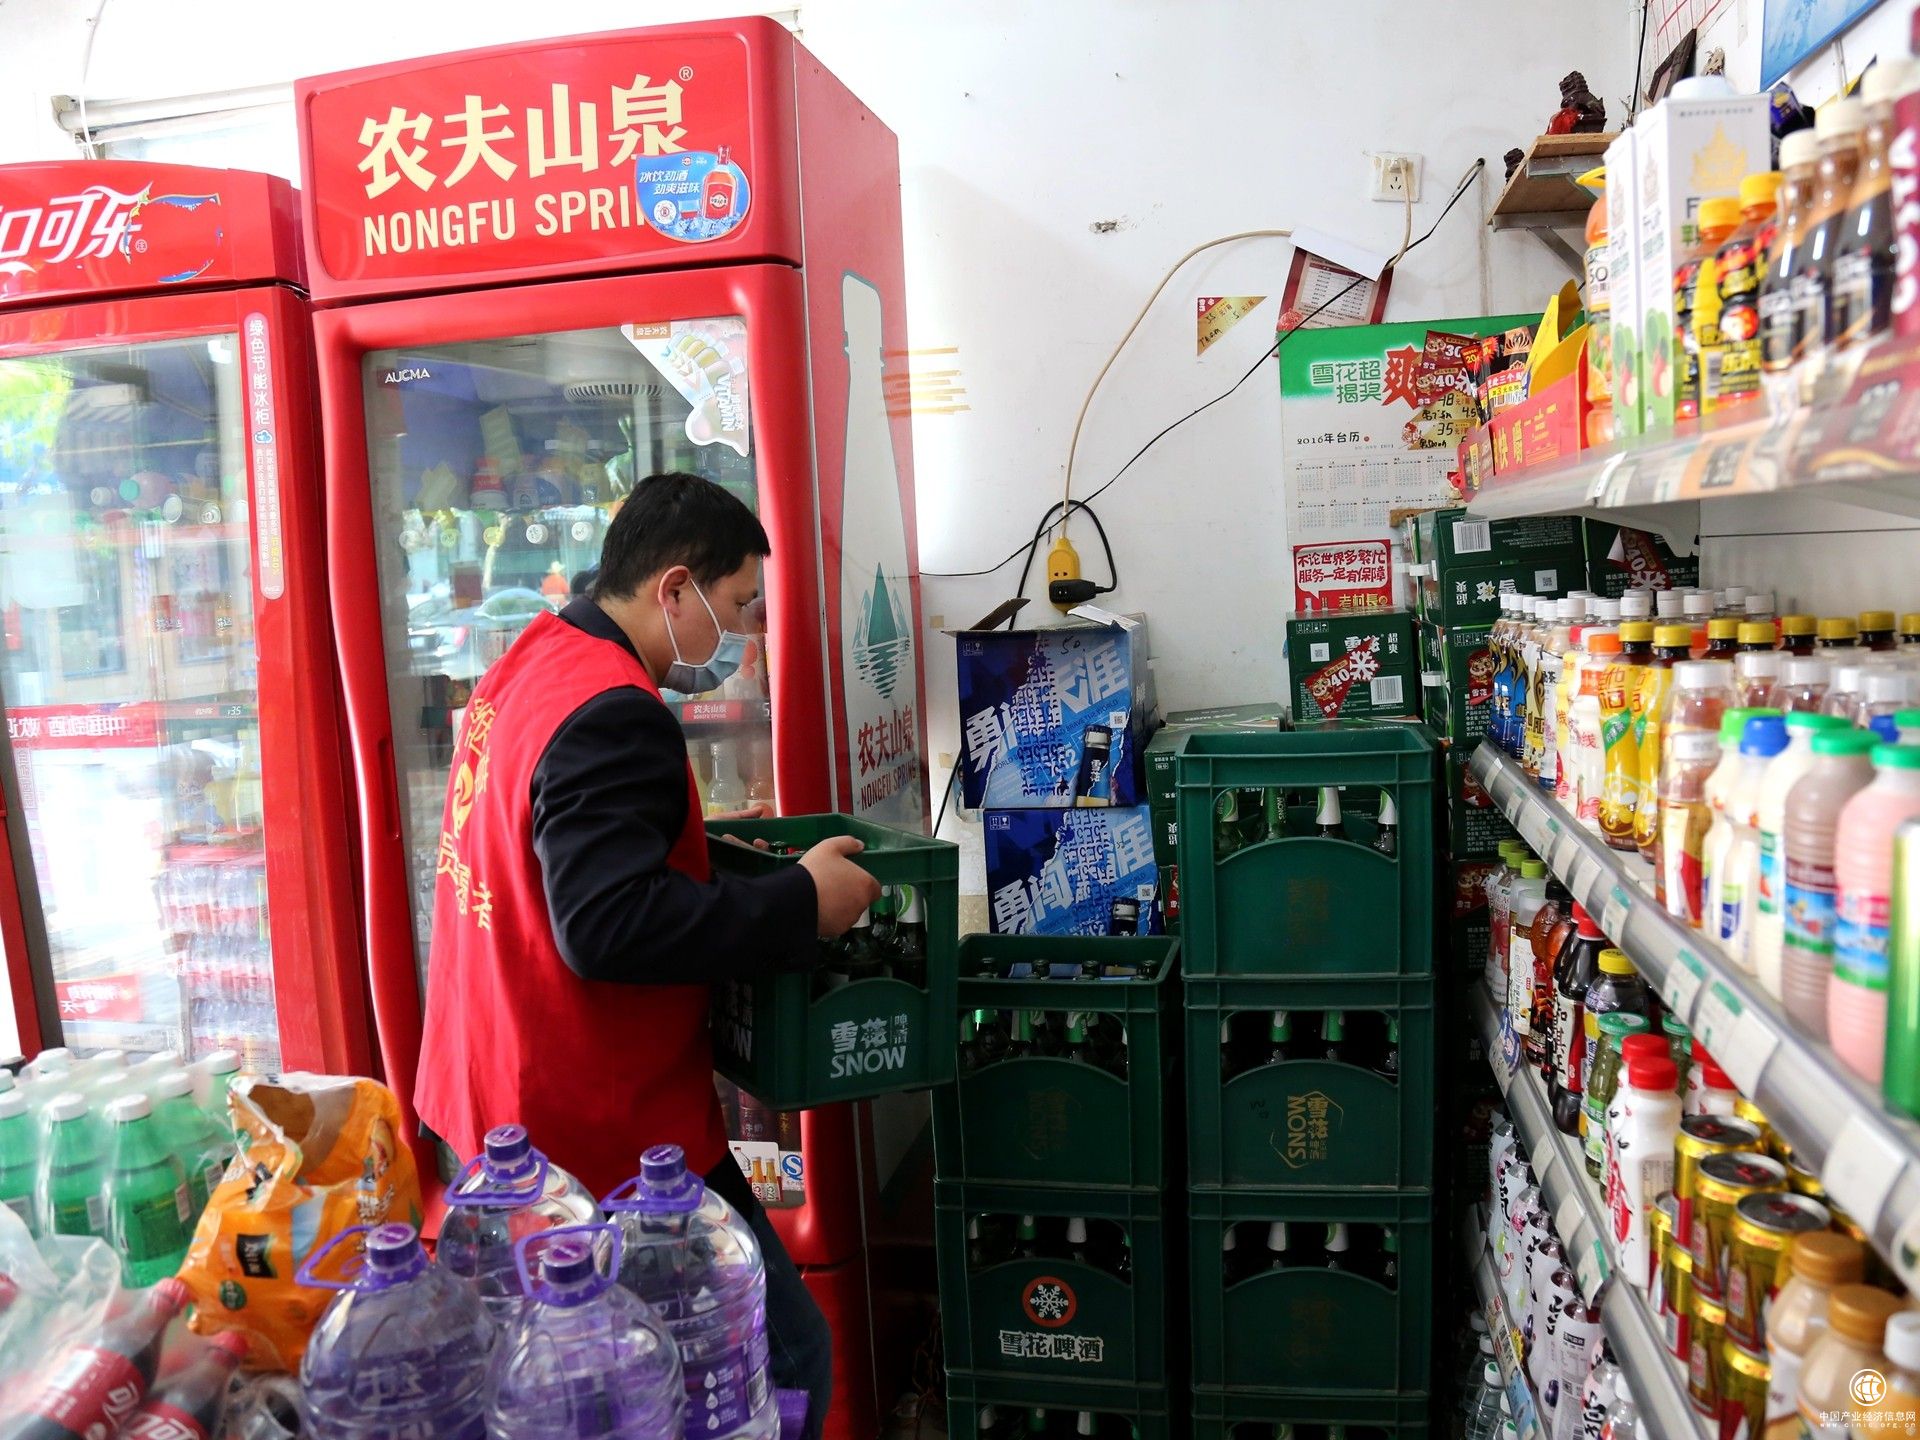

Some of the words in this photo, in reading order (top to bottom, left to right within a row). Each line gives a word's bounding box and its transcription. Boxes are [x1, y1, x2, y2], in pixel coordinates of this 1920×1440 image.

[357, 74, 689, 199] 农夫山泉
[363, 198, 516, 257] NONGFU
[535, 186, 645, 237] SPRI
[250, 319, 270, 426] 绿色节能冰柜
[384, 367, 430, 384] AUCMA
[1311, 361, 1381, 384] 雪花超
[1435, 374, 1455, 388] 40
[1336, 382, 1382, 404] 揭奖
[1297, 432, 1360, 445] 2016年台历
[1298, 549, 1386, 567] 不论世界多繁忙
[1299, 566, 1386, 583] 服务一定有保障
[1455, 580, 1468, 606] 超爽
[1387, 632, 1399, 654] 超爽
[1331, 668, 1351, 687] 40
[857, 704, 914, 778] 农夫山泉
[860, 772, 892, 811] NONGFU
[893, 758, 917, 791] SPRING
[829, 1016, 888, 1054] 雪花
[894, 1012, 908, 1045] 啤酒
[829, 1045, 906, 1079] SNOW
[1287, 1096, 1307, 1160] SNOW
[999, 1329, 1105, 1363] 雪花啤酒
